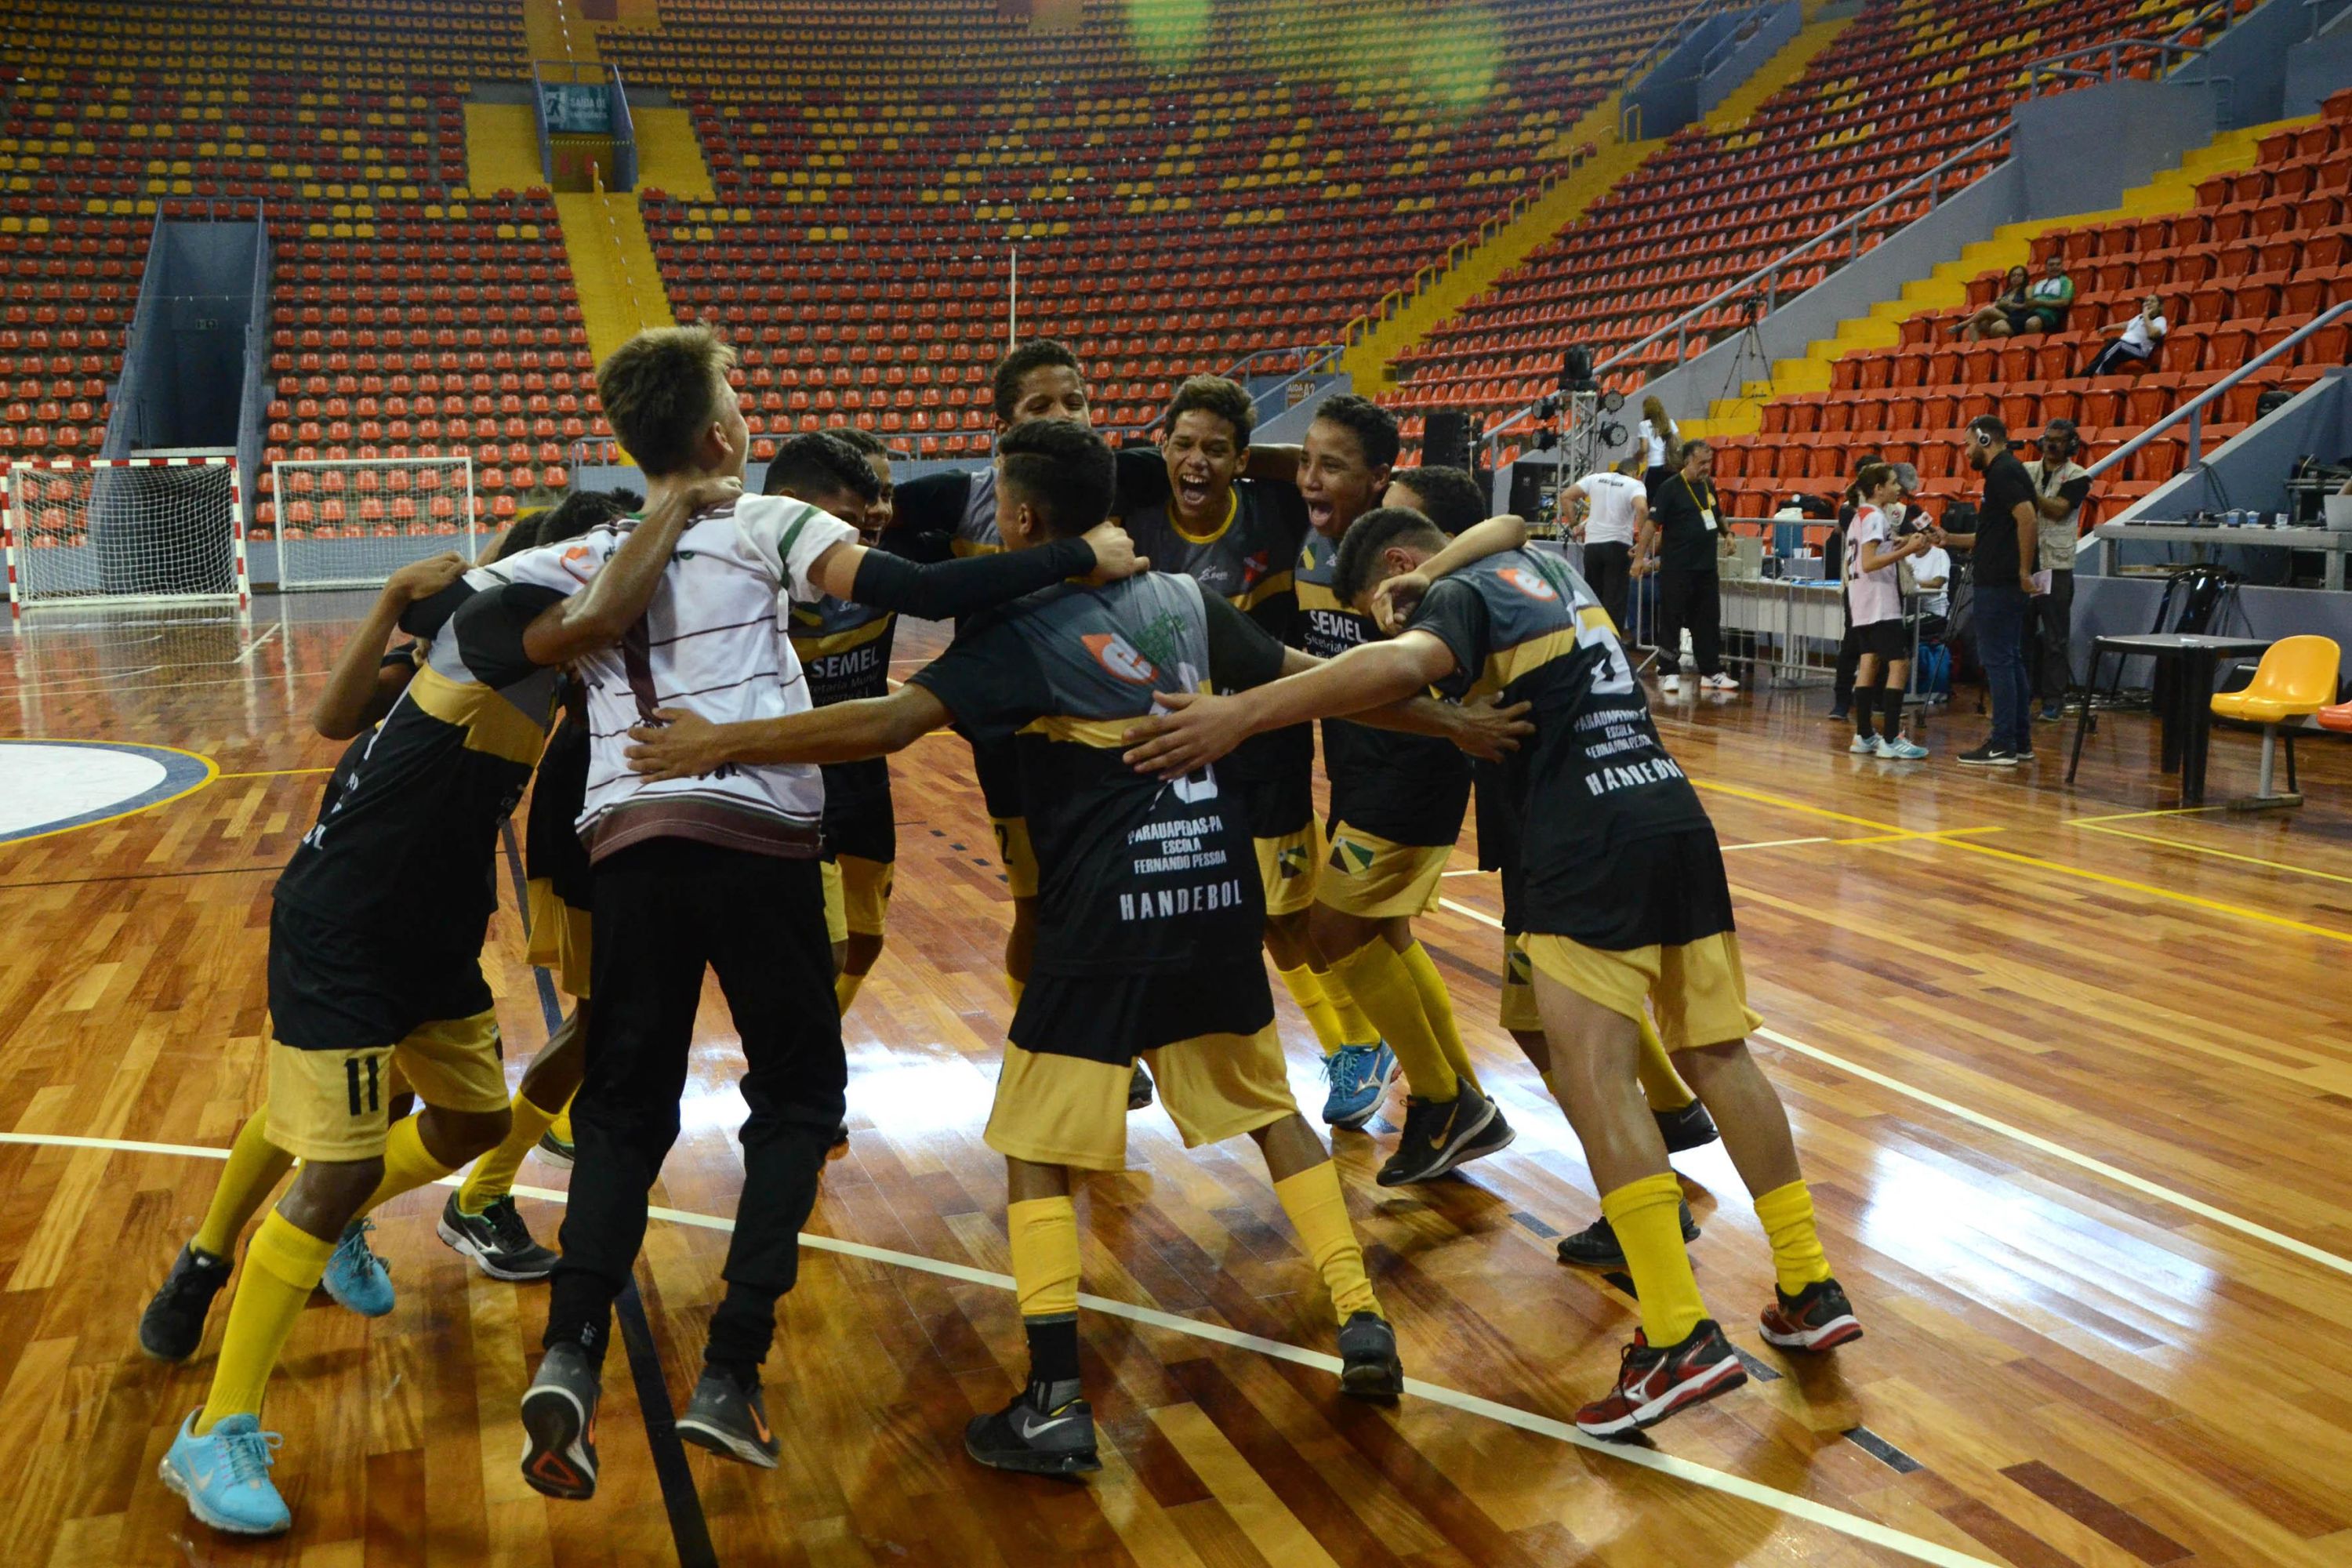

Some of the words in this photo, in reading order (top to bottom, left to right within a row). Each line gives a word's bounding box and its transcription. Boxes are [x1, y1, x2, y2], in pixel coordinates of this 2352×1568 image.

[811, 647, 879, 678] SEMEL
[1127, 815, 1223, 845] PARAUAPEBAS-PA
[1162, 837, 1202, 855] ESCOLA
[1134, 855, 1191, 874] FERNANDO
[1192, 850, 1227, 868] PESSOA
[1120, 879, 1242, 920] HANDEBOL
[343, 1054, 379, 1116] 11
